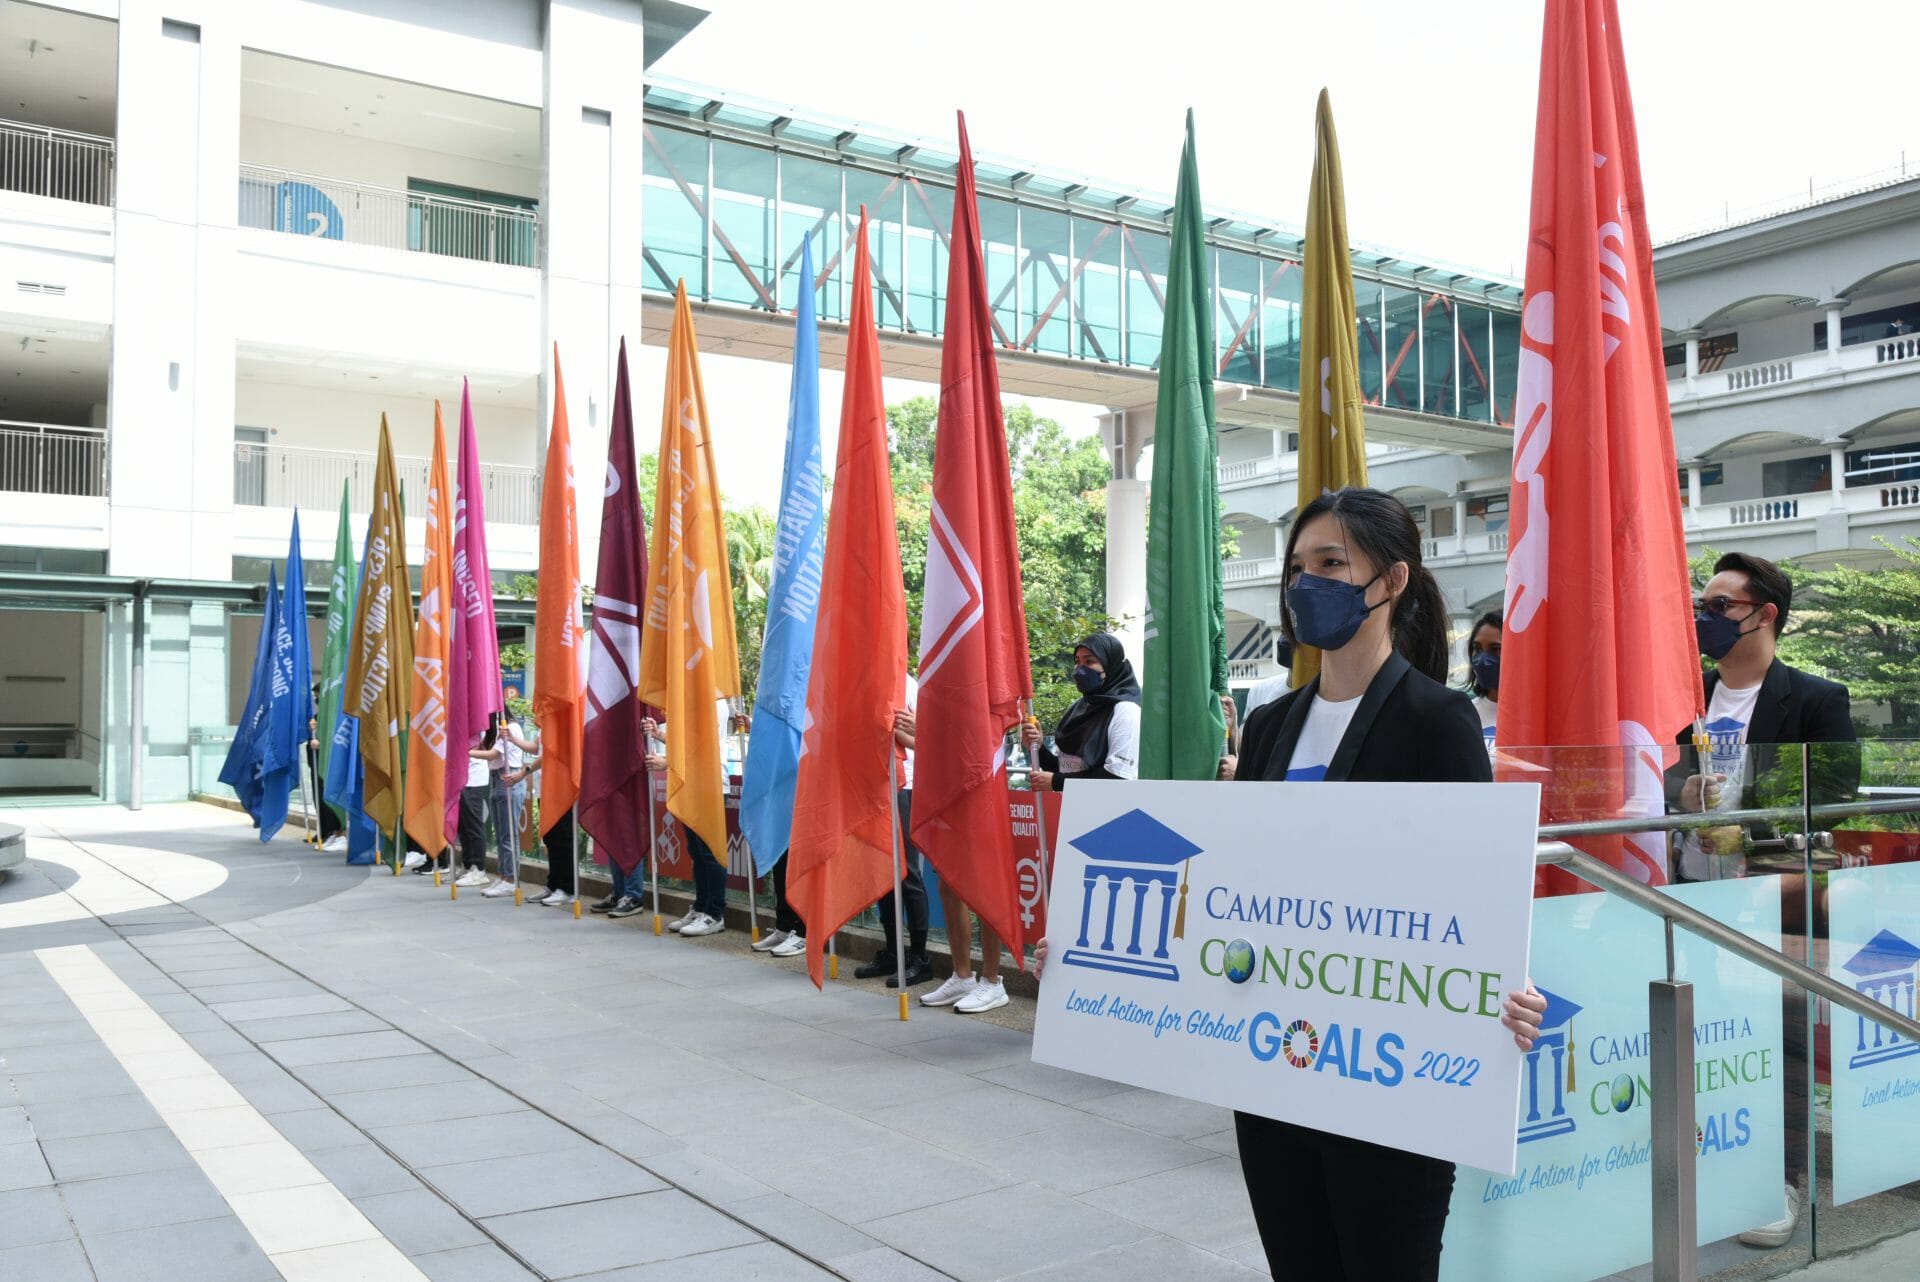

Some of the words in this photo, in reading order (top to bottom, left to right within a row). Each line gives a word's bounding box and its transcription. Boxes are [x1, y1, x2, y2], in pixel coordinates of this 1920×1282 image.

[1011, 821, 1039, 837] QUALIT
[1205, 886, 1333, 931] CAMPUS
[1344, 905, 1432, 942] WITH
[1440, 915, 1465, 945] A
[1200, 938, 1502, 1018] CONSCIENCE
[1066, 989, 1107, 1016] Local
[1107, 996, 1154, 1026] Action
[1155, 1004, 1182, 1038] for
[1186, 1009, 1246, 1042] Global
[1248, 1011, 1405, 1087] GOALS
[1414, 1051, 1480, 1086] 2022
[1741, 1017, 1752, 1037] A
[1862, 1080, 1891, 1108] Local
[1483, 1167, 1527, 1204] Local
[1529, 1164, 1576, 1191] Action
[1577, 1153, 1601, 1190] for
[1605, 1139, 1652, 1172] Global
